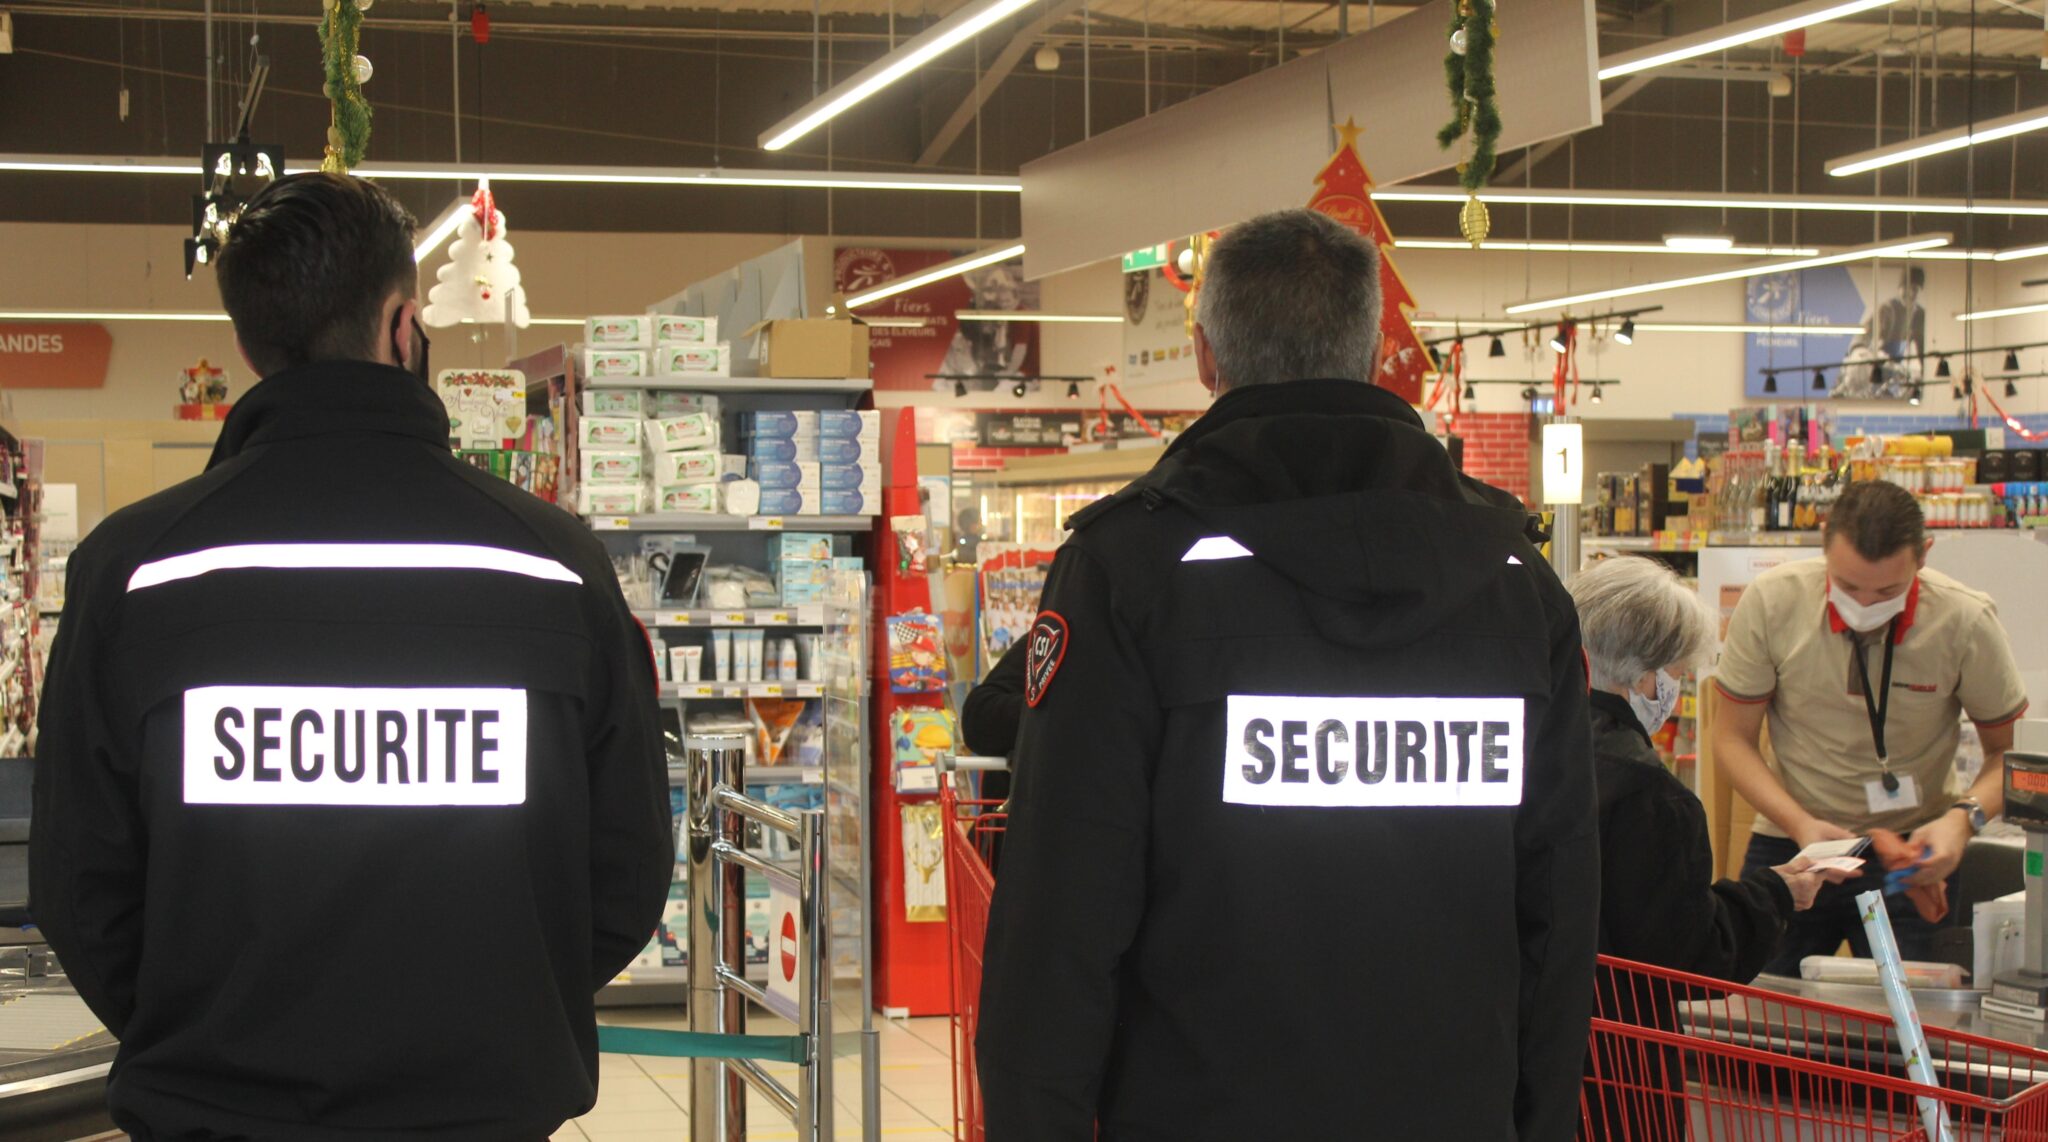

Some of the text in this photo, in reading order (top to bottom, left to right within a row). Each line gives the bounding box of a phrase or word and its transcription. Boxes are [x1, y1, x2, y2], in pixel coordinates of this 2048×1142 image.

[1556, 447, 1567, 474] 1
[1035, 635, 1050, 656] CSI
[213, 706, 500, 784] SECURITE
[1241, 717, 1510, 785] SECURITE
